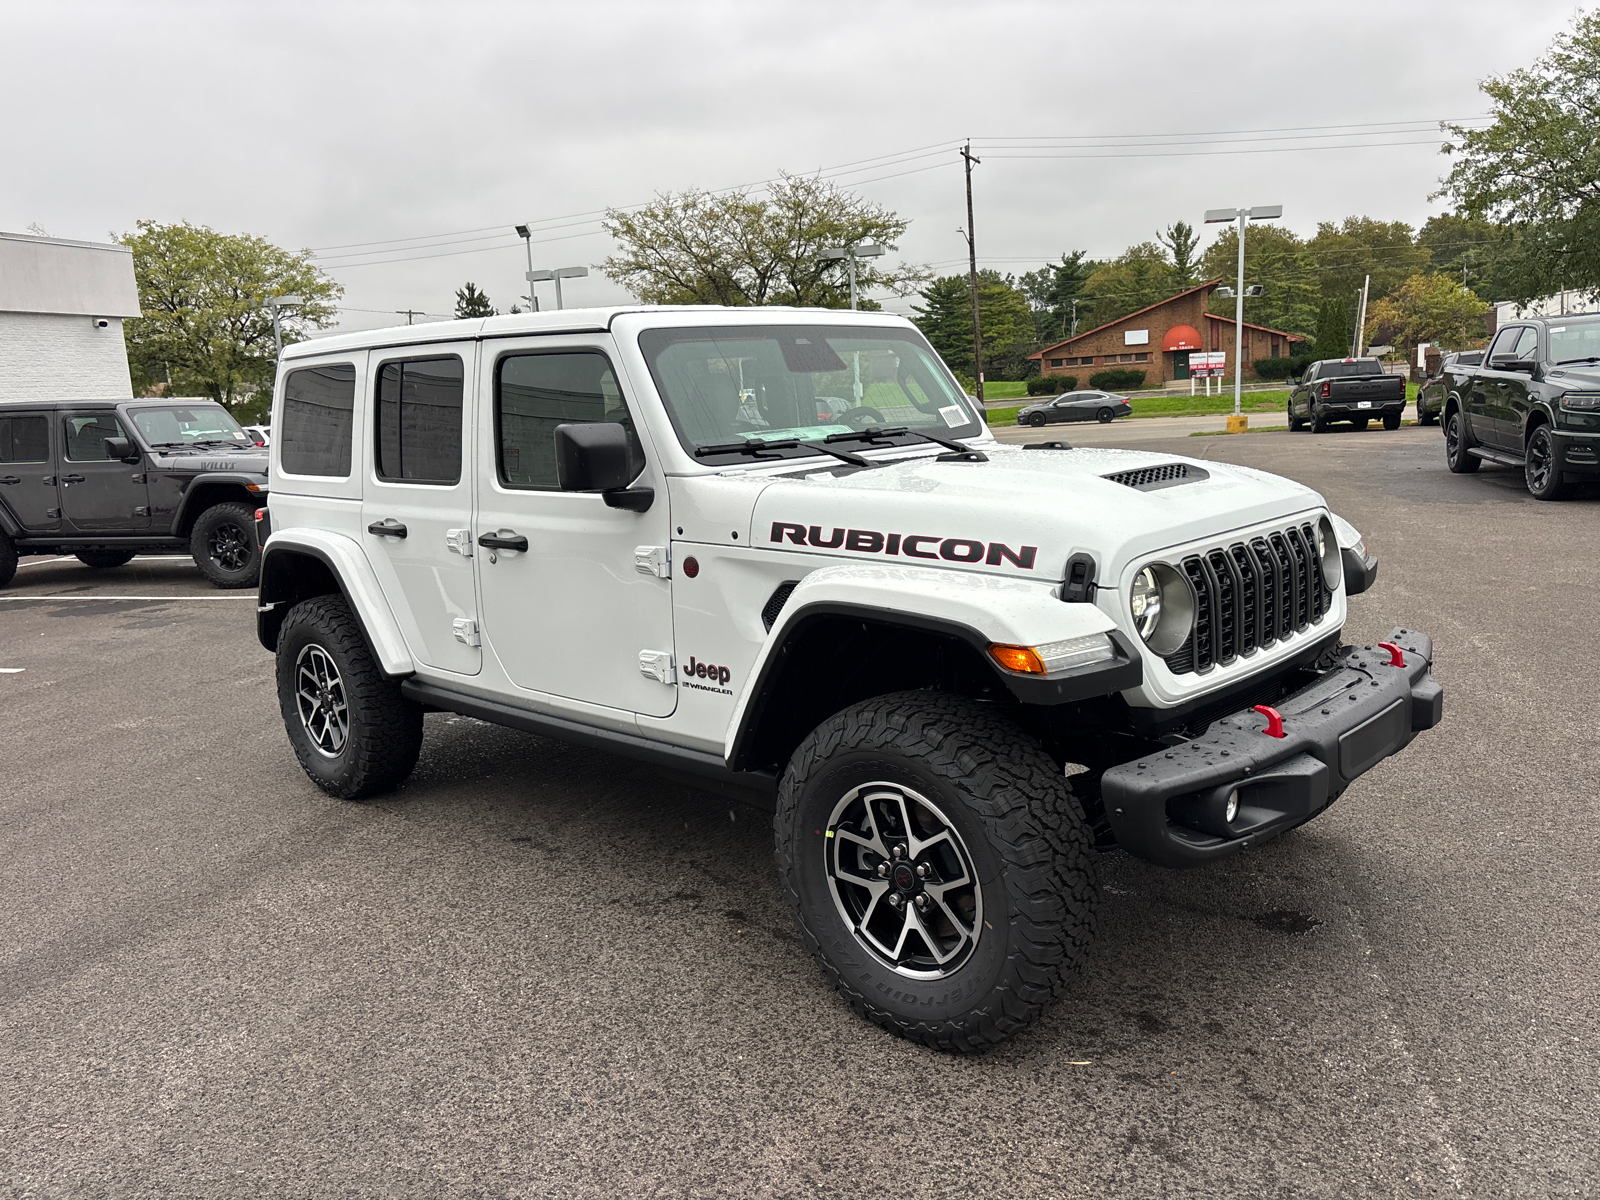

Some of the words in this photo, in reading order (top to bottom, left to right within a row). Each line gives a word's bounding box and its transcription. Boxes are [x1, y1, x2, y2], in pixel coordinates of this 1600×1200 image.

[200, 461, 237, 470] WILLYS
[770, 521, 1037, 570] RUBICON
[683, 655, 731, 686] Jeep
[689, 682, 733, 695] WRANGLER
